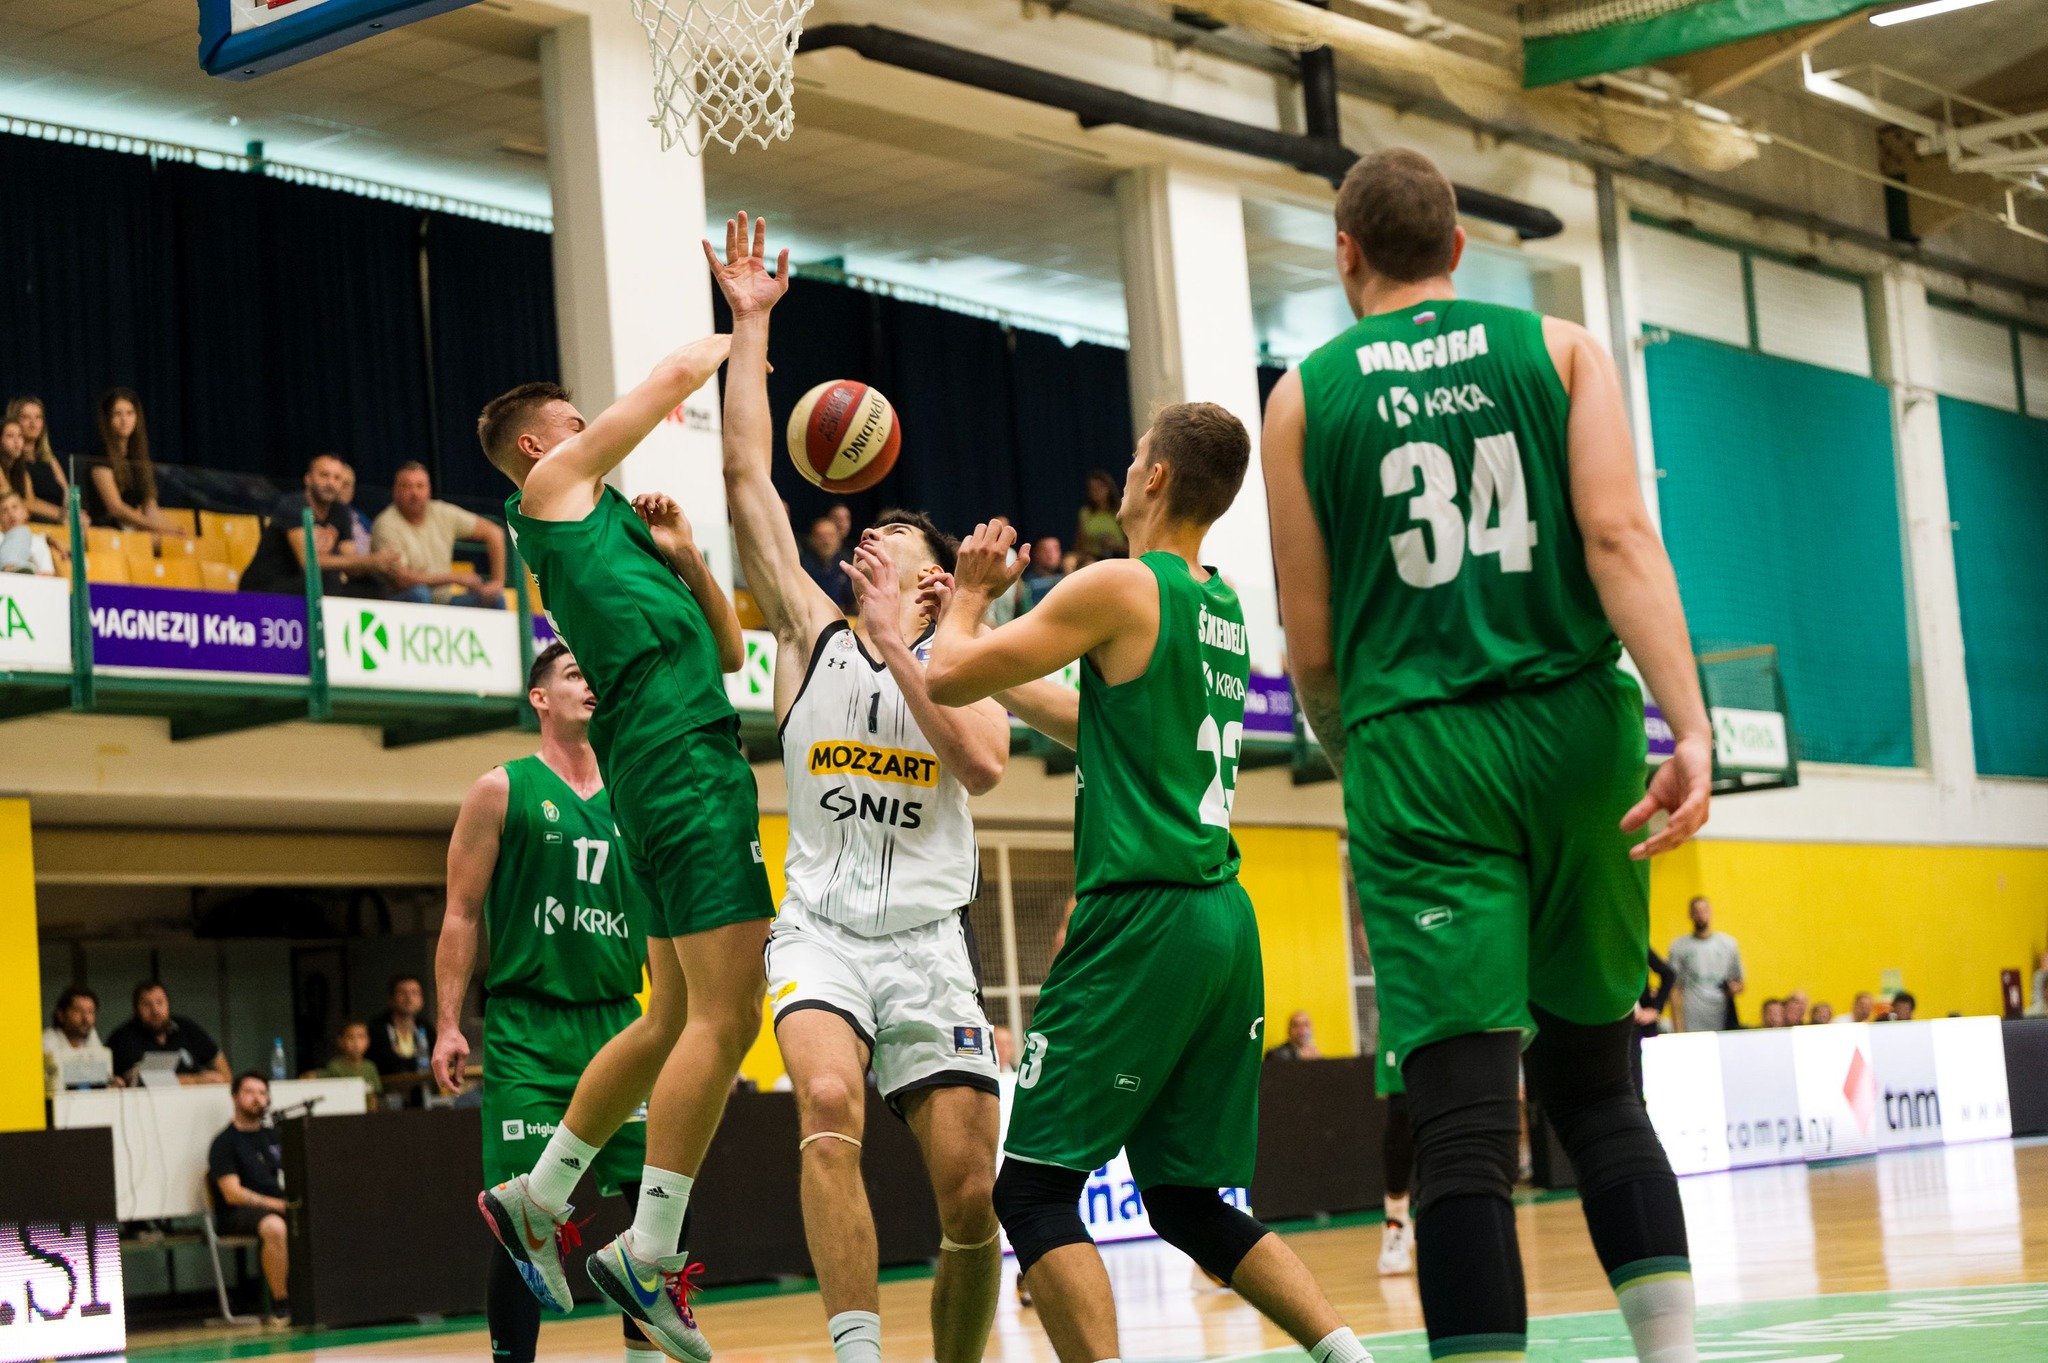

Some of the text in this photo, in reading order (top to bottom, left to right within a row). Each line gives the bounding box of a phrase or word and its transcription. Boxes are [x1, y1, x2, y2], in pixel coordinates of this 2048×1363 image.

[1356, 324, 1488, 375] MAGURA
[1425, 384, 1495, 417] KRKA
[841, 394, 886, 463] SPALDING
[1380, 431, 1538, 589] 34
[89, 607, 303, 650] MAGNEZIJ Krka 300
[400, 624, 492, 667] KRKA
[1216, 671, 1246, 700] KRKA
[868, 691, 881, 733] 1
[811, 745, 936, 783] MOZZART
[859, 792, 923, 829] NIS
[573, 836, 610, 885] 17
[573, 905, 629, 939] KRK
[1884, 1086, 1941, 1130] tnm
[526, 1122, 558, 1138] trigla
[1727, 1115, 1833, 1152] company
